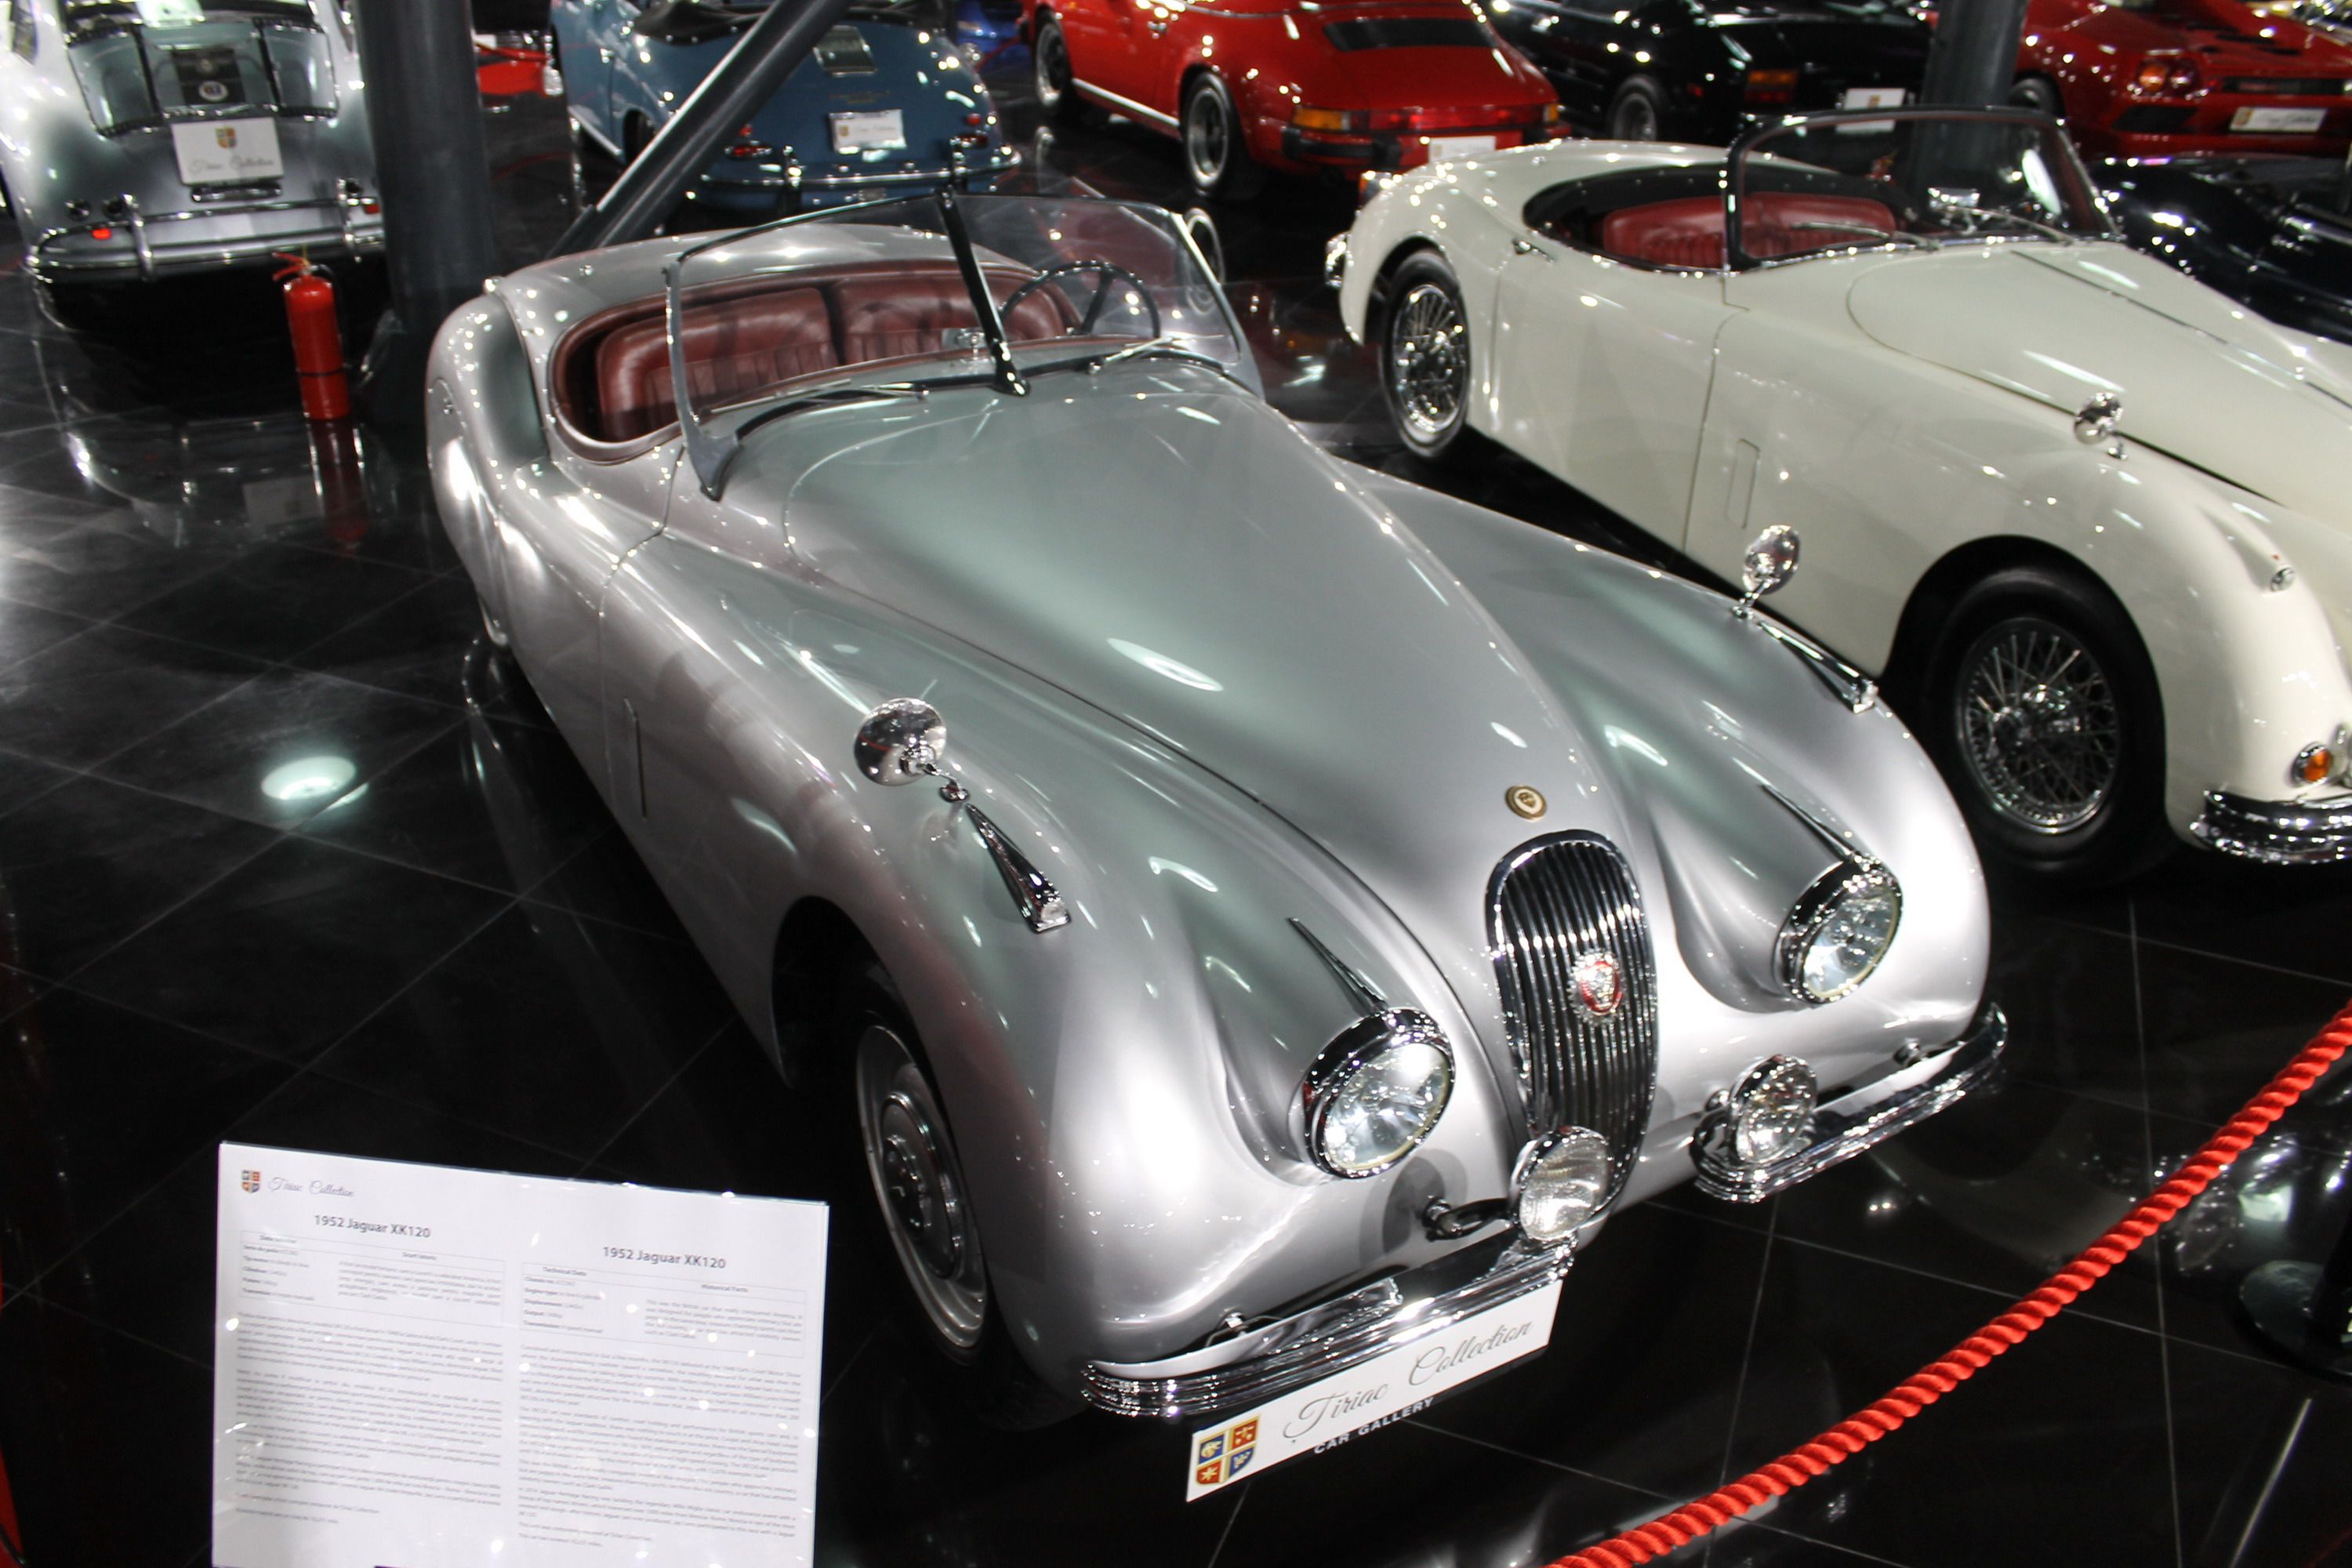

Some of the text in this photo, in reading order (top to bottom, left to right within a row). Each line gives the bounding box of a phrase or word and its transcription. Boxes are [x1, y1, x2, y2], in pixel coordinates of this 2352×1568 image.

[314, 1214, 431, 1238] 1952 Jaguar XK120
[603, 1247, 726, 1269] 1952 Jaguar XK120
[1408, 1321, 1532, 1386] Collection
[1314, 1396, 1435, 1454] CAR GALLERY
